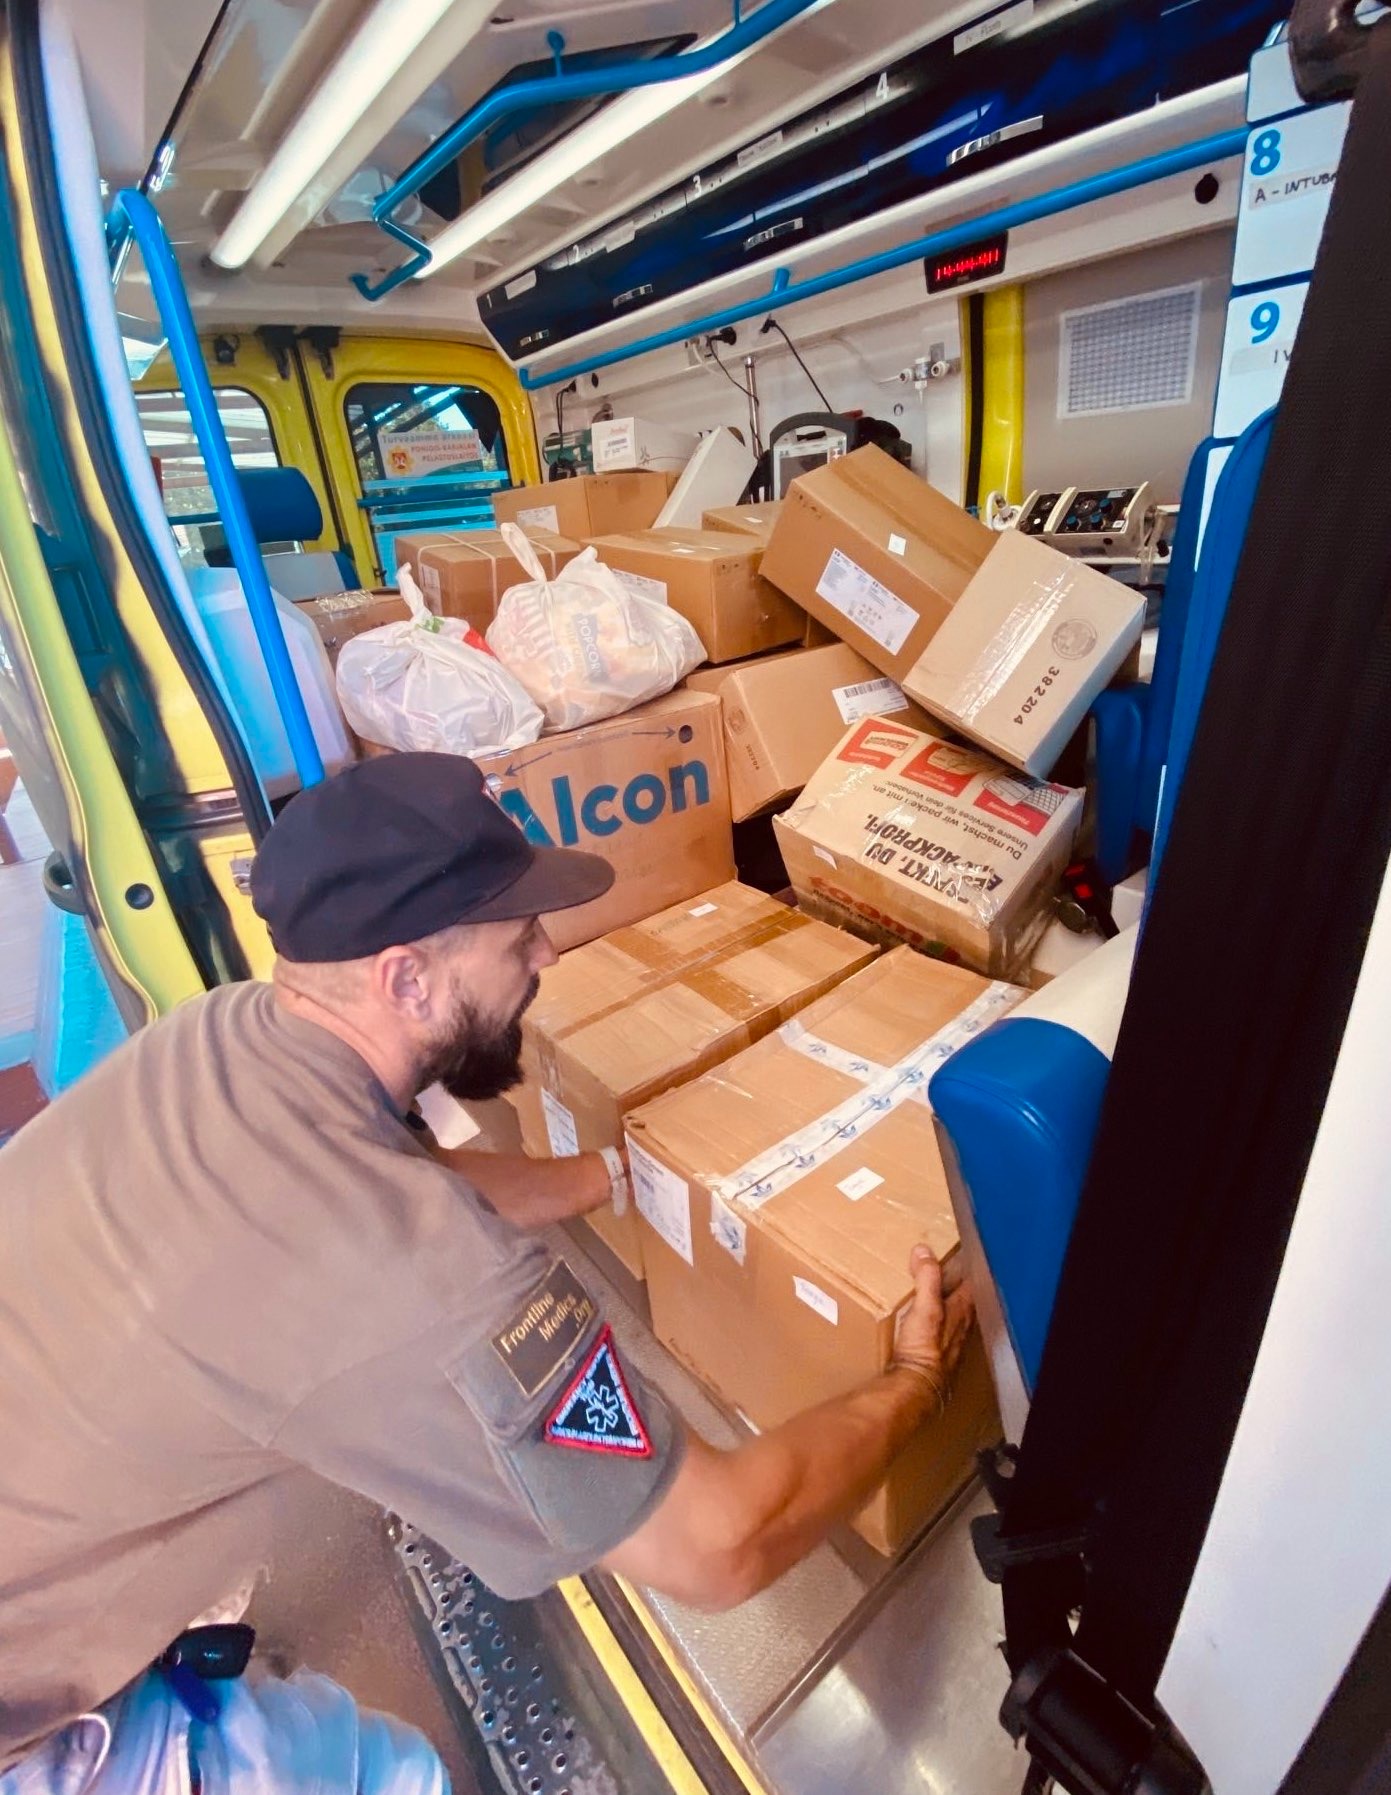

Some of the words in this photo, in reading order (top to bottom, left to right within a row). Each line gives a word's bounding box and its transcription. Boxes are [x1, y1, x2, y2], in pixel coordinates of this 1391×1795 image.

[875, 72, 890, 100] 4
[1250, 129, 1281, 176] 8
[693, 175, 702, 198] 3
[1255, 188, 1266, 204] A
[572, 244, 580, 263] 2
[486, 293, 493, 309] 1
[1250, 301, 1280, 344] 9
[498, 760, 710, 848] Alcon
[942, 815, 960, 827] wir
[962, 824, 1007, 852] machst,
[864, 842, 898, 866] DU
[1008, 845, 1023, 861] Du
[499, 1291, 555, 1355] Frontline
[538, 1293, 577, 1343] Medics
